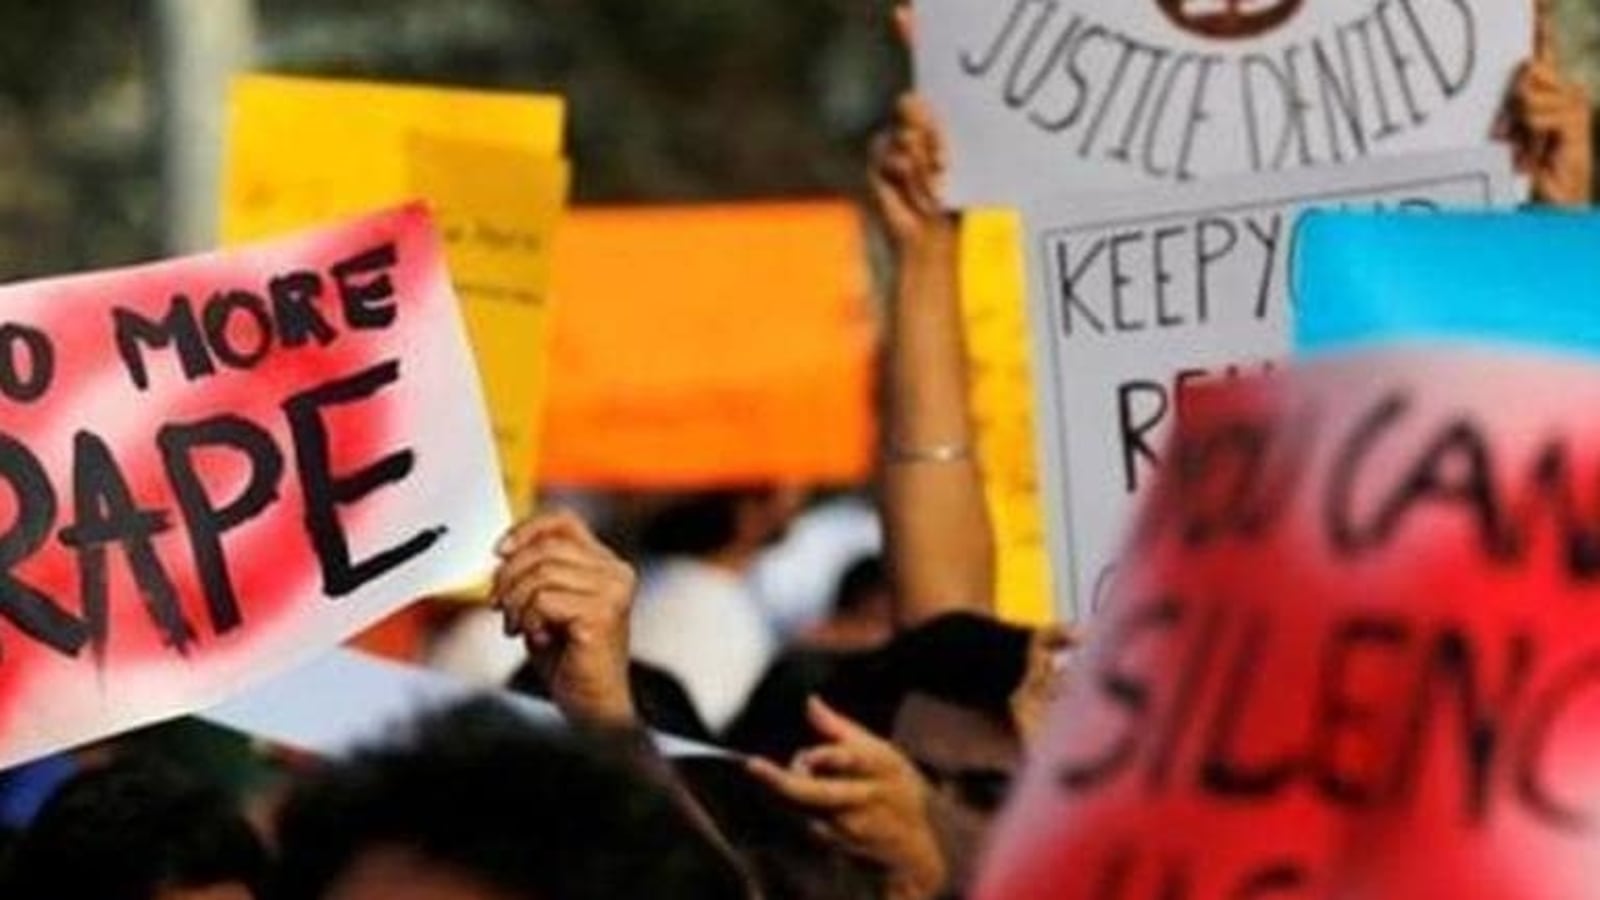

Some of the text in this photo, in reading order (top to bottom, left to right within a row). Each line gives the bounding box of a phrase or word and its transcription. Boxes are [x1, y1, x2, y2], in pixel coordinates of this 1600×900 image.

[957, 0, 1475, 181] JUSTICE DENIED
[111, 242, 398, 391] MORE
